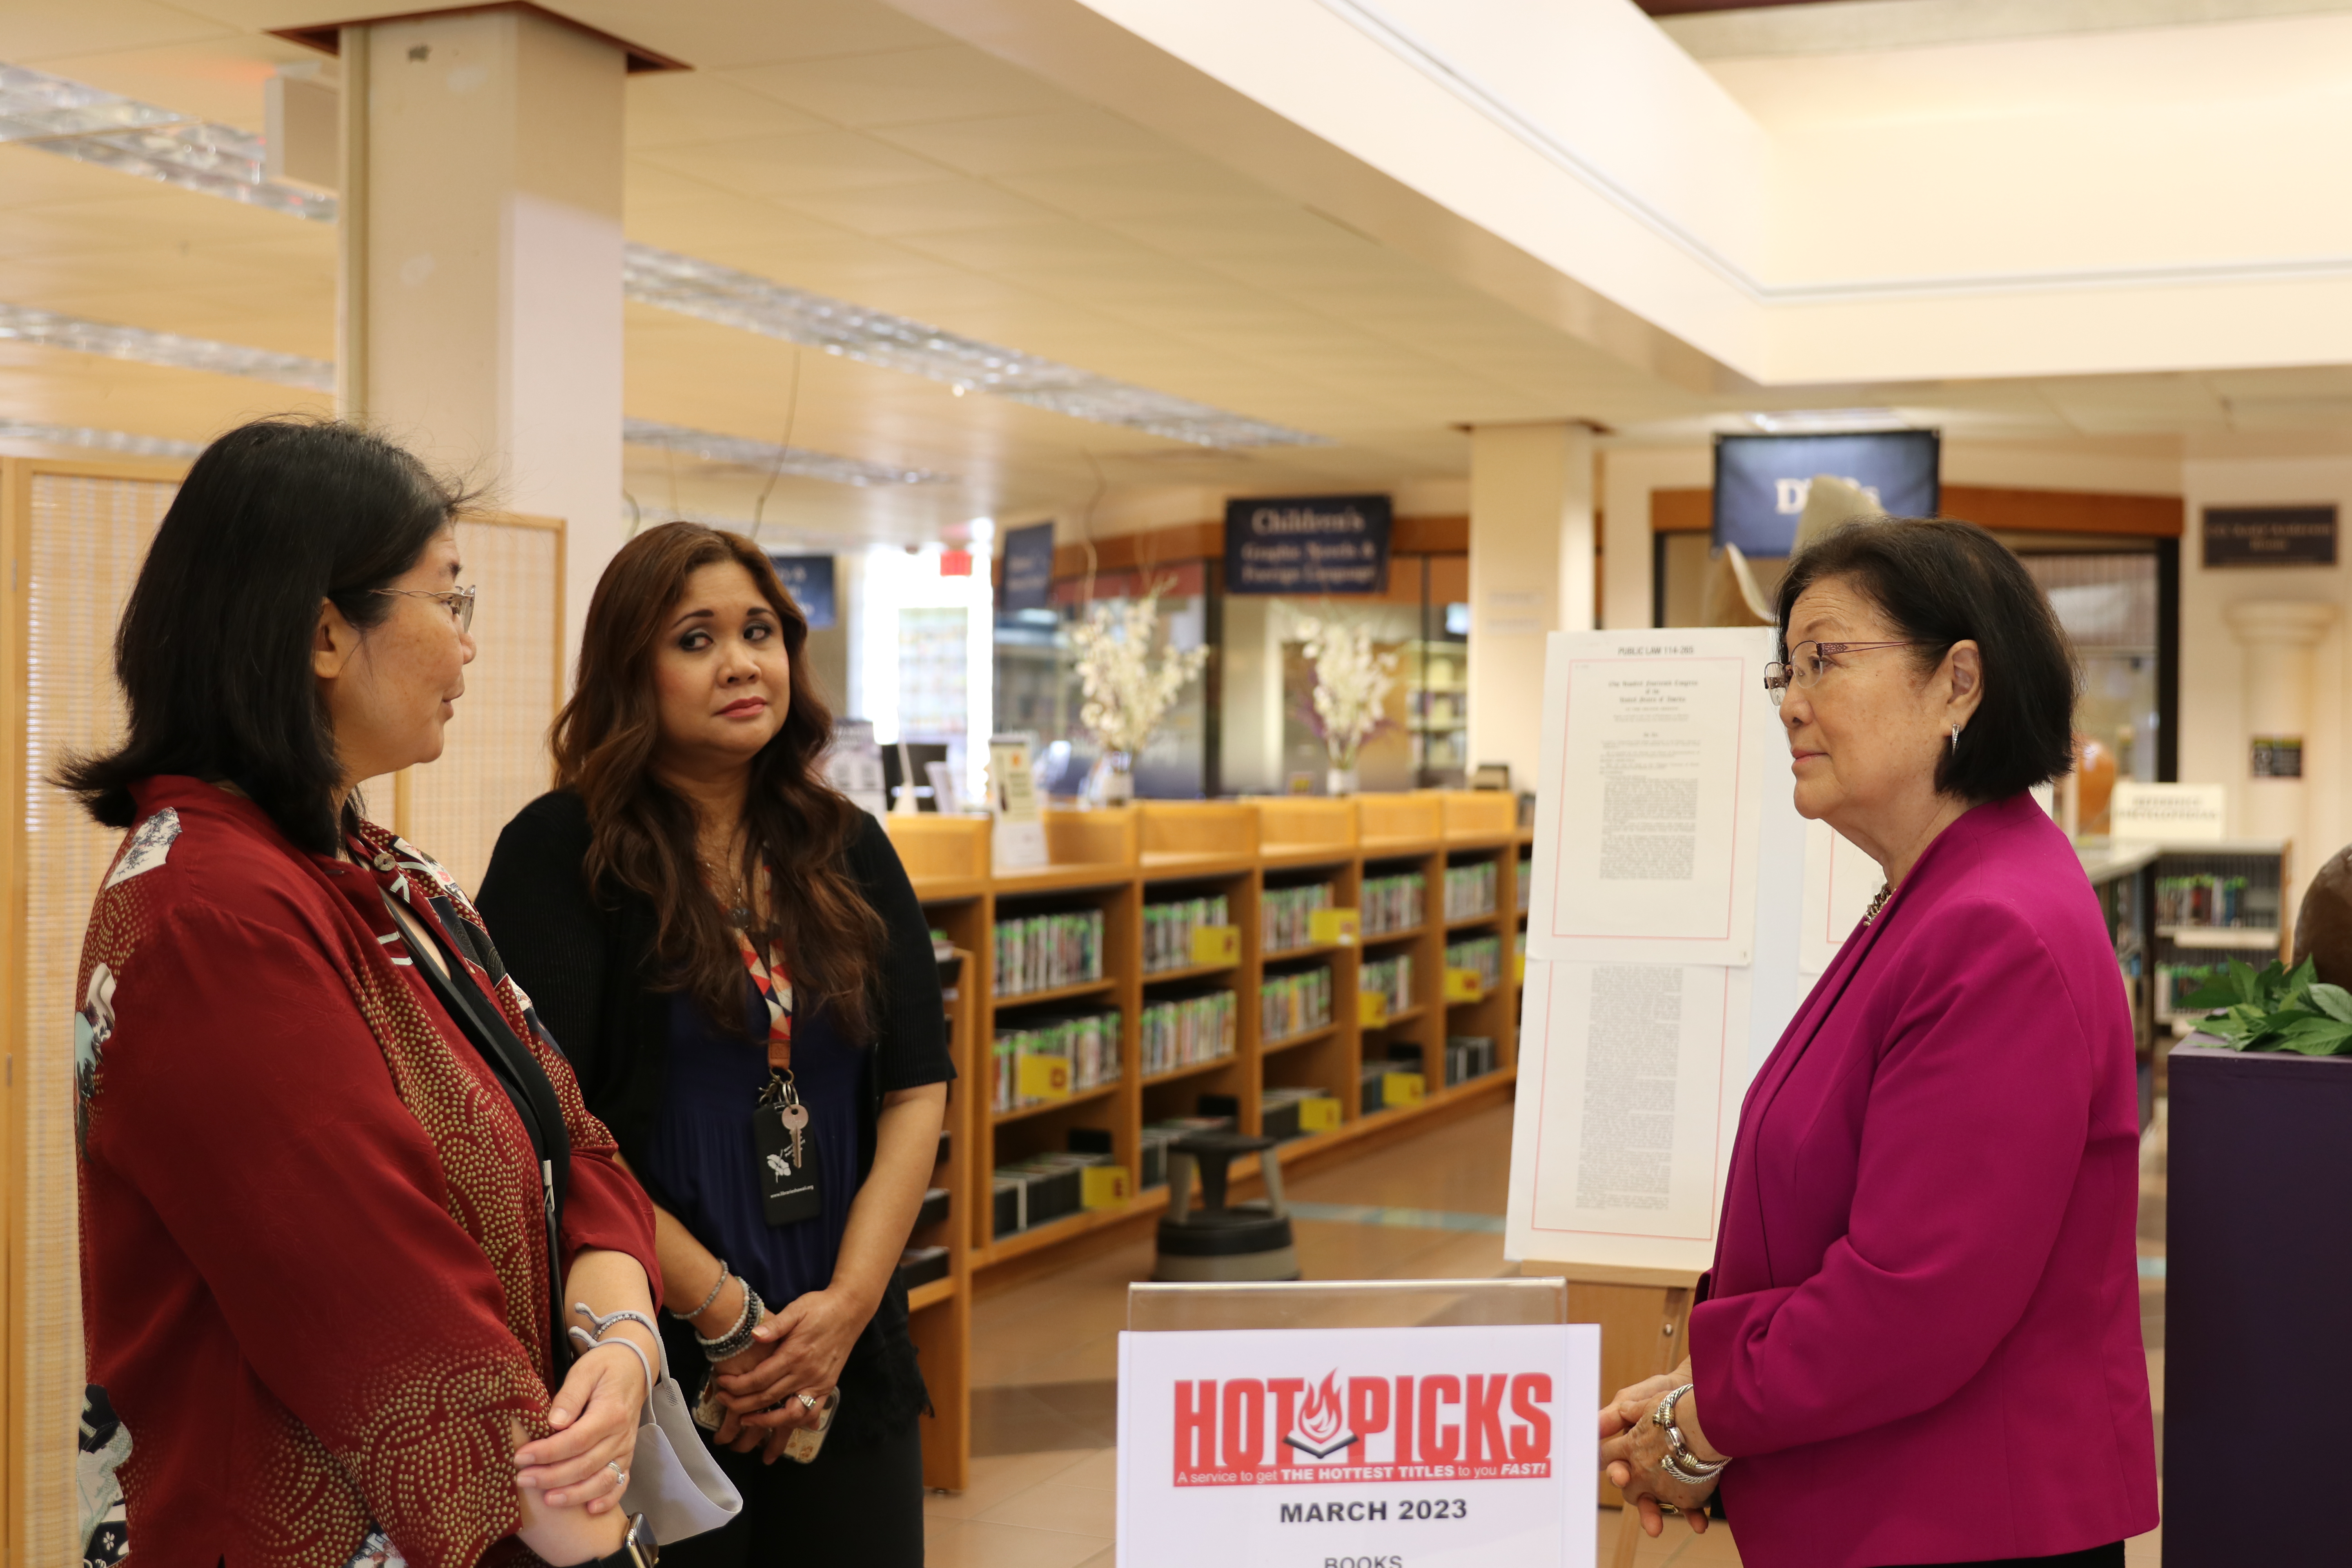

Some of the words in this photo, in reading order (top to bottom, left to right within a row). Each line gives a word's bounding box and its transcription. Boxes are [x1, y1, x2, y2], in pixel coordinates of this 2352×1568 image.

[1251, 508, 1366, 534] Children's
[1618, 646, 1643, 655] PUBLIC
[1645, 646, 1661, 654] LAW
[1174, 1377, 1305, 1467] HOT
[1348, 1372, 1552, 1463] PICKS
[1177, 1472, 1187, 1483] A
[1191, 1472, 1236, 1482] service
[1241, 1471, 1253, 1481] to
[1257, 1470, 1277, 1483] get
[1281, 1468, 1313, 1480] THE
[1318, 1466, 1393, 1479] HOTTEST
[1398, 1465, 1455, 1477] TITLES
[1458, 1466, 1470, 1476] to
[1474, 1467, 1496, 1478] you
[1501, 1463, 1546, 1475] FAST!
[1281, 1500, 1387, 1523] MARCH
[1399, 1499, 1467, 1519] 2023
[1325, 1556, 1402, 1568] BOOKS
